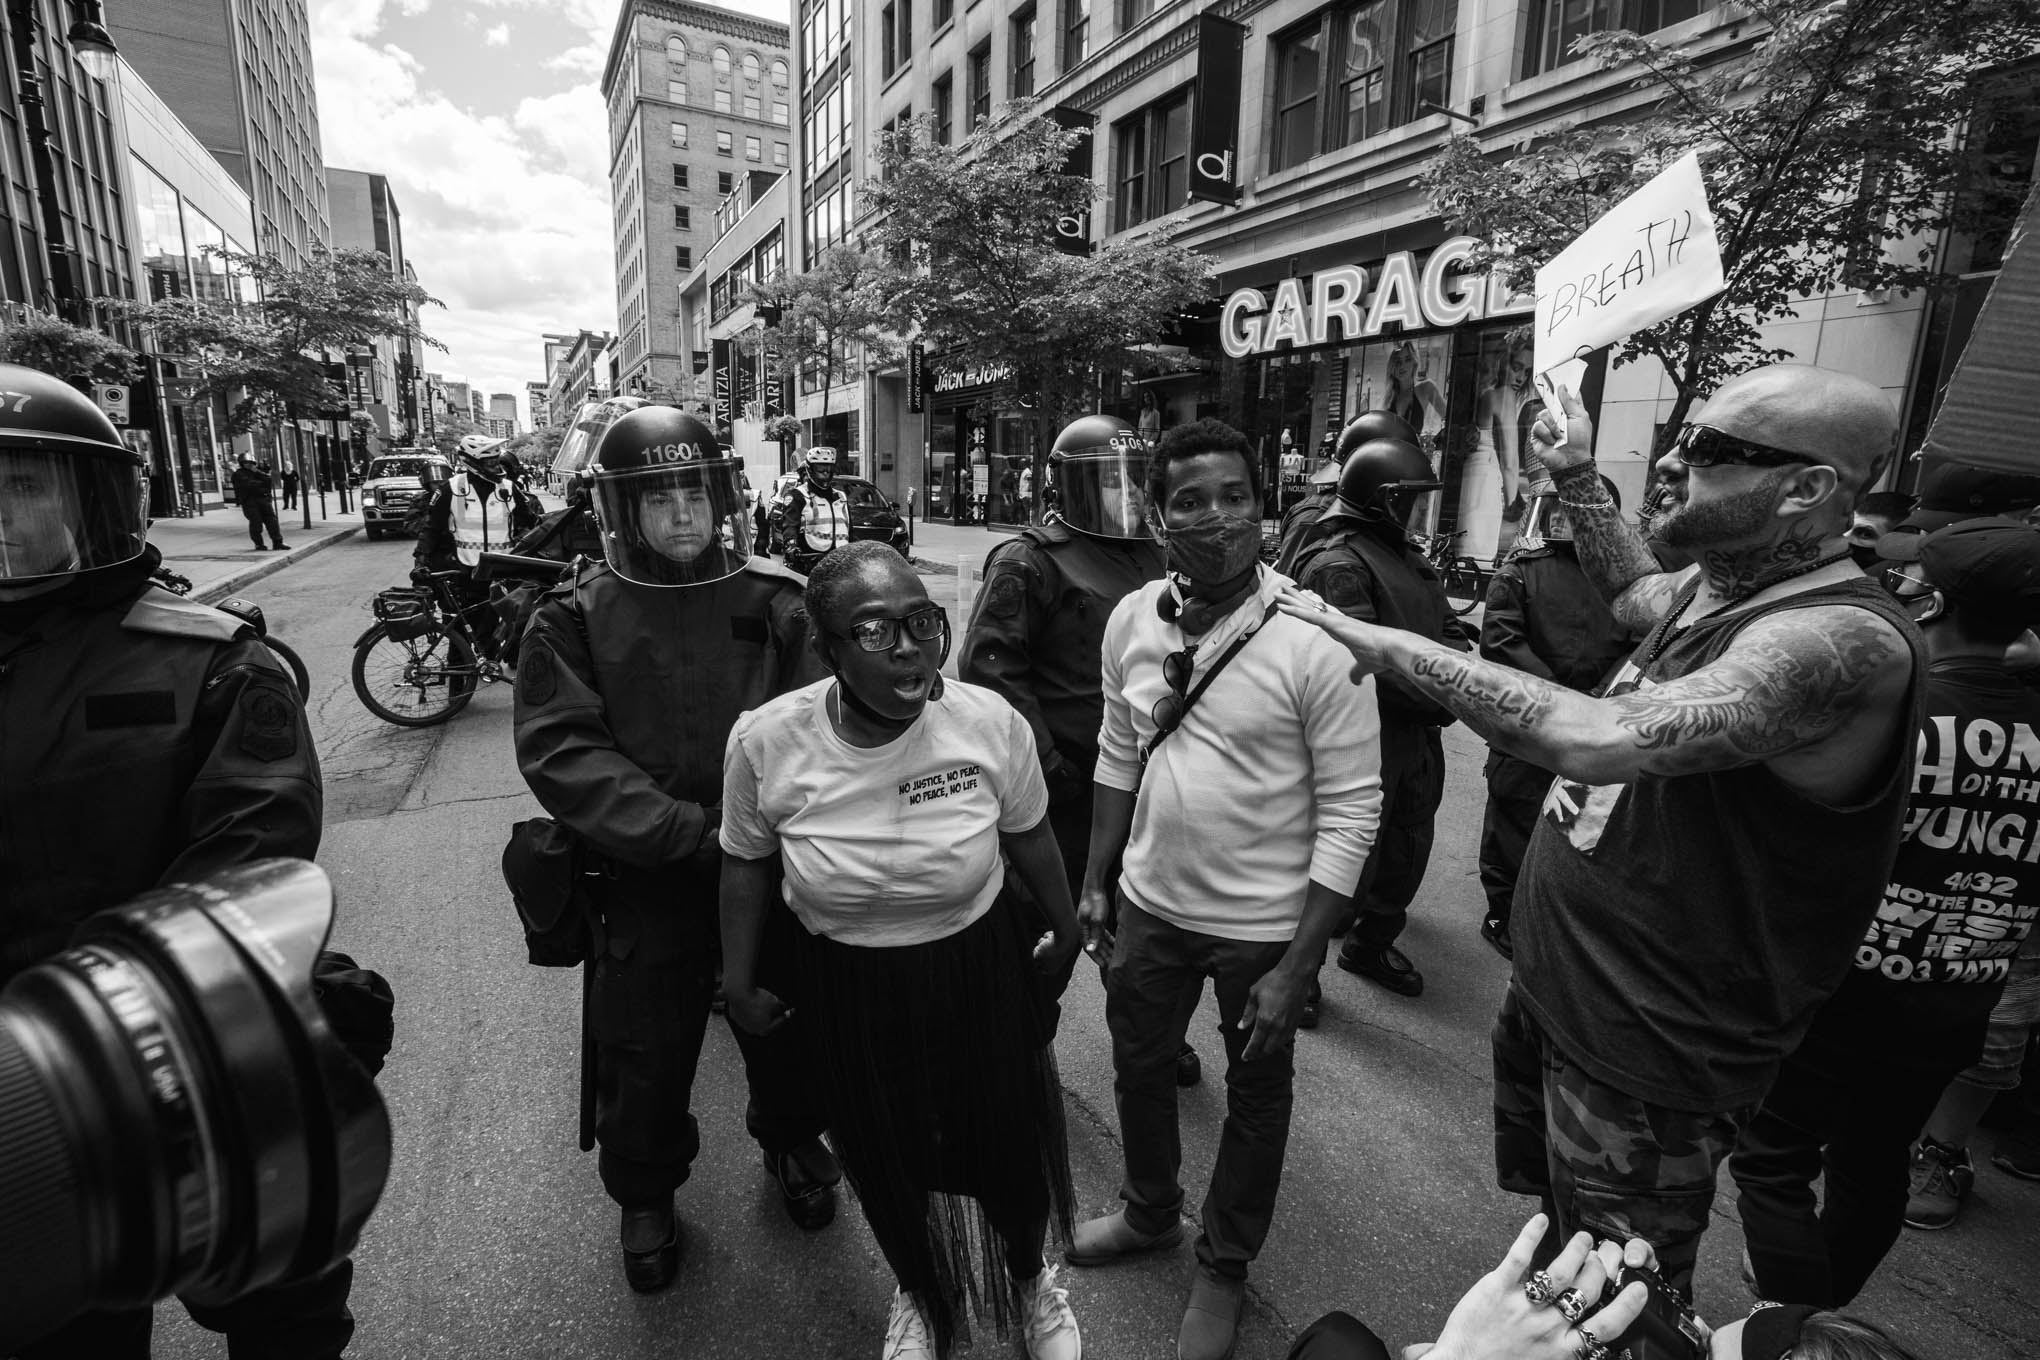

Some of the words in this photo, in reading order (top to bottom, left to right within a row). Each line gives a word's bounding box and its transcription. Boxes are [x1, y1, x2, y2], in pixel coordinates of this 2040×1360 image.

[1547, 209, 1691, 338] BREATH
[716, 366, 730, 423] ARITZIA
[934, 372, 964, 392] JACK
[0, 391, 32, 412] 7
[913, 386, 921, 408] JACK
[641, 442, 703, 464] 11604
[898, 782, 911, 795] NO
[913, 774, 946, 791] JUSTICE,
[947, 770, 958, 781] NO
[960, 765, 980, 779] PEACE
[909, 793, 921, 806] NO
[923, 787, 948, 802] PEACE,
[950, 782, 961, 795] NO
[963, 779, 978, 791] LIFE
[1960, 773, 1992, 797] OF
[1884, 882, 1969, 911] NOTRE
[1944, 871, 2019, 898] 4632
[1875, 898, 2032, 941] WEST
